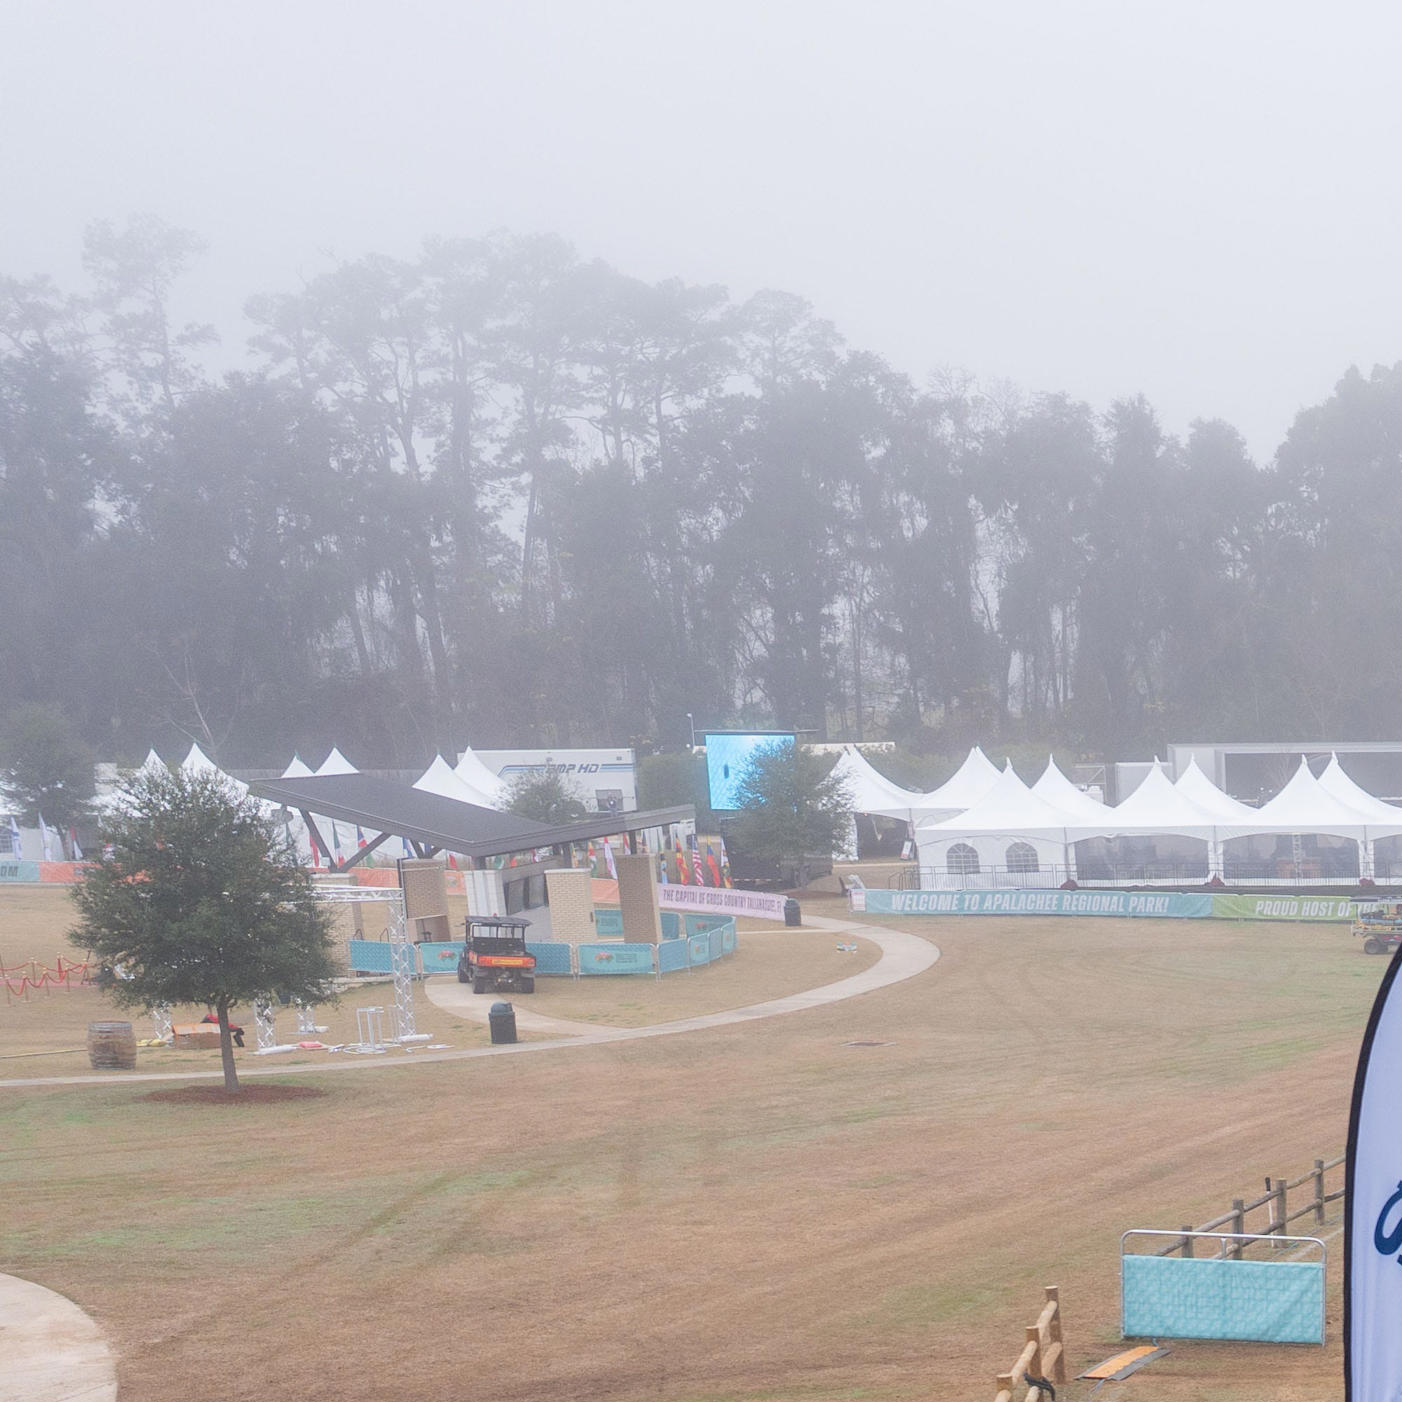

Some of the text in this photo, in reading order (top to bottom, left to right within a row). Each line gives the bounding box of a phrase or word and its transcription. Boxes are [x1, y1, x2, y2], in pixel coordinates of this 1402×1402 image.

[577, 763, 599, 774] HD
[891, 893, 1169, 913] WELCOME TO APALACHEE REGIONAL PARK!
[1256, 901, 1298, 916] PROUD
[1301, 901, 1335, 916] HOST
[1337, 901, 1353, 916] OF
